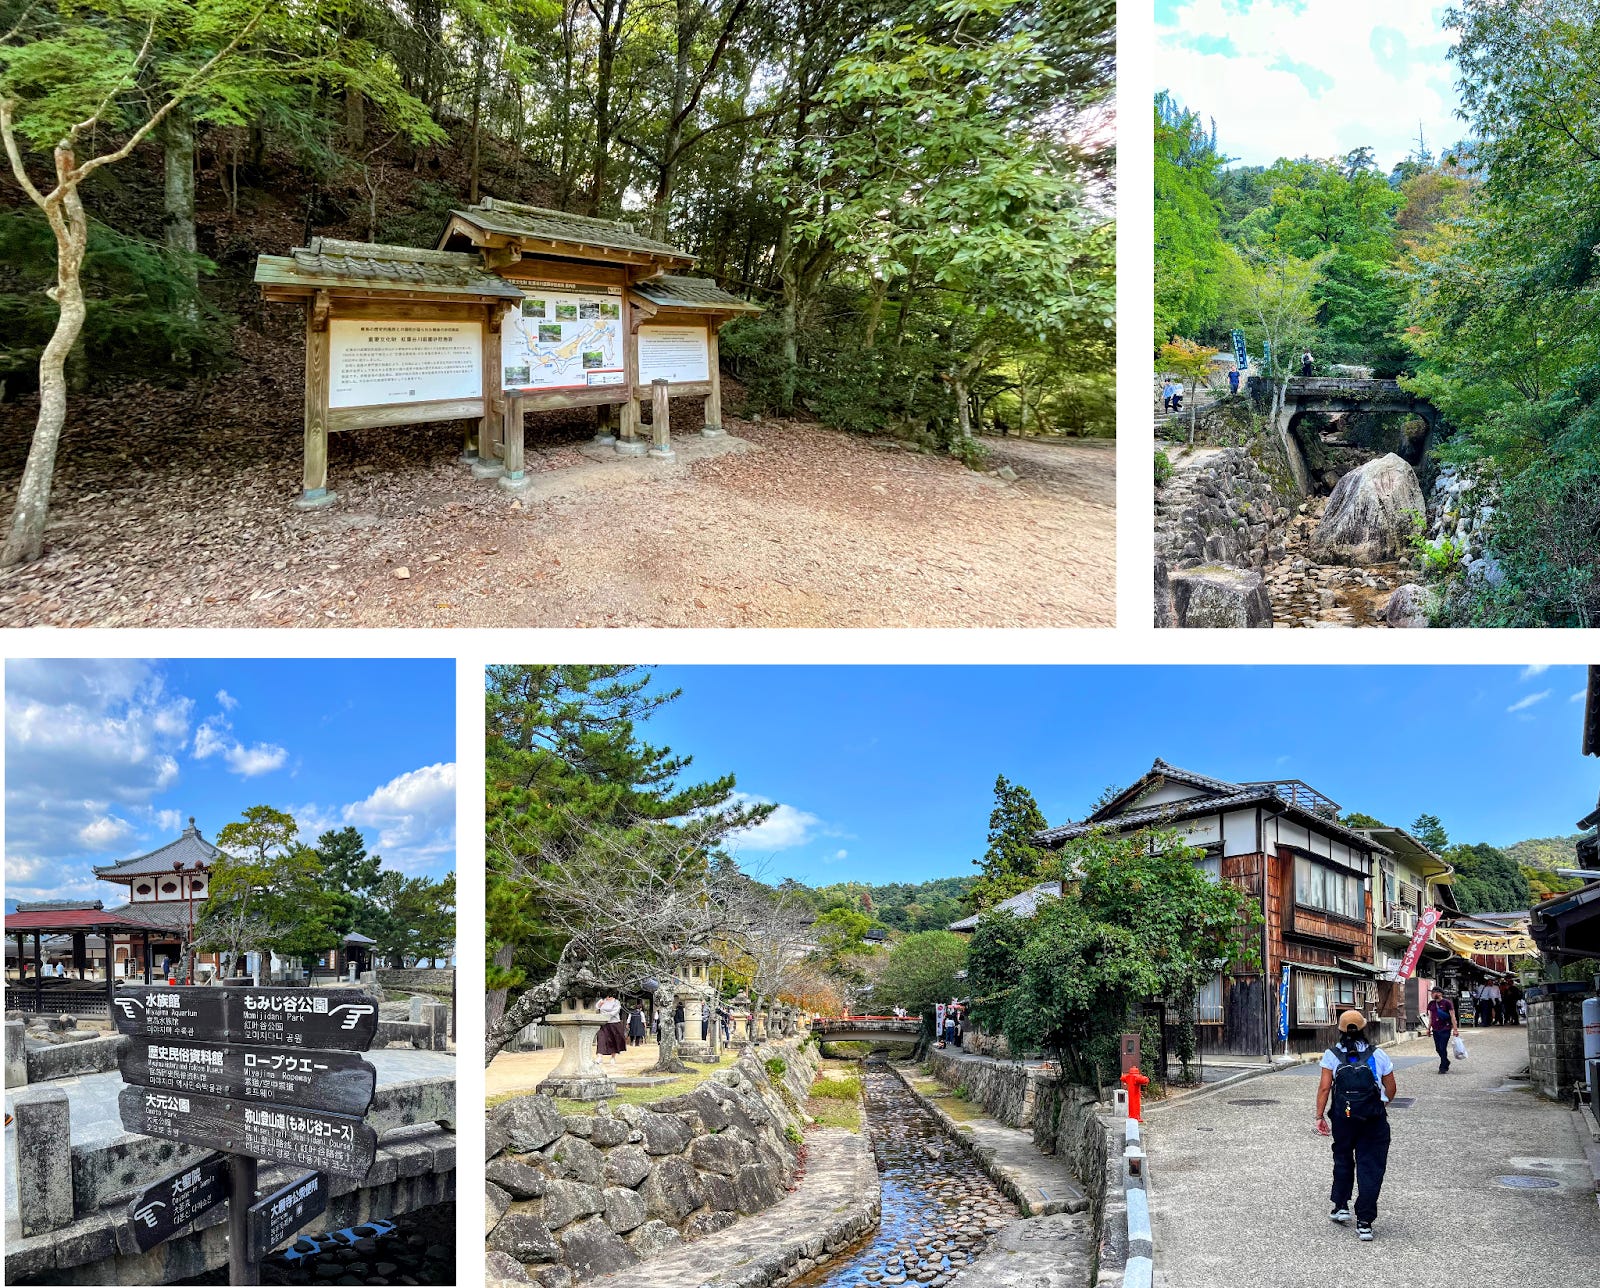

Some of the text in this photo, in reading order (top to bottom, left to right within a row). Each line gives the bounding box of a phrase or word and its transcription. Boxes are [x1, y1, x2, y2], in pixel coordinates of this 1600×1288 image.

[145, 993, 181, 1009] 水族館
[244, 995, 328, 1014] もみじ谷公園
[243, 1011, 304, 1022] Momijidani Park
[148, 1045, 224, 1066] 歴史民俗資料館
[244, 1054, 328, 1072] ロープウエー
[244, 1068, 312, 1084] Miyajima Ropeway
[146, 1094, 190, 1113] 大元公園
[164, 1110, 178, 1119] Park
[172, 1167, 201, 1197] 大聖院
